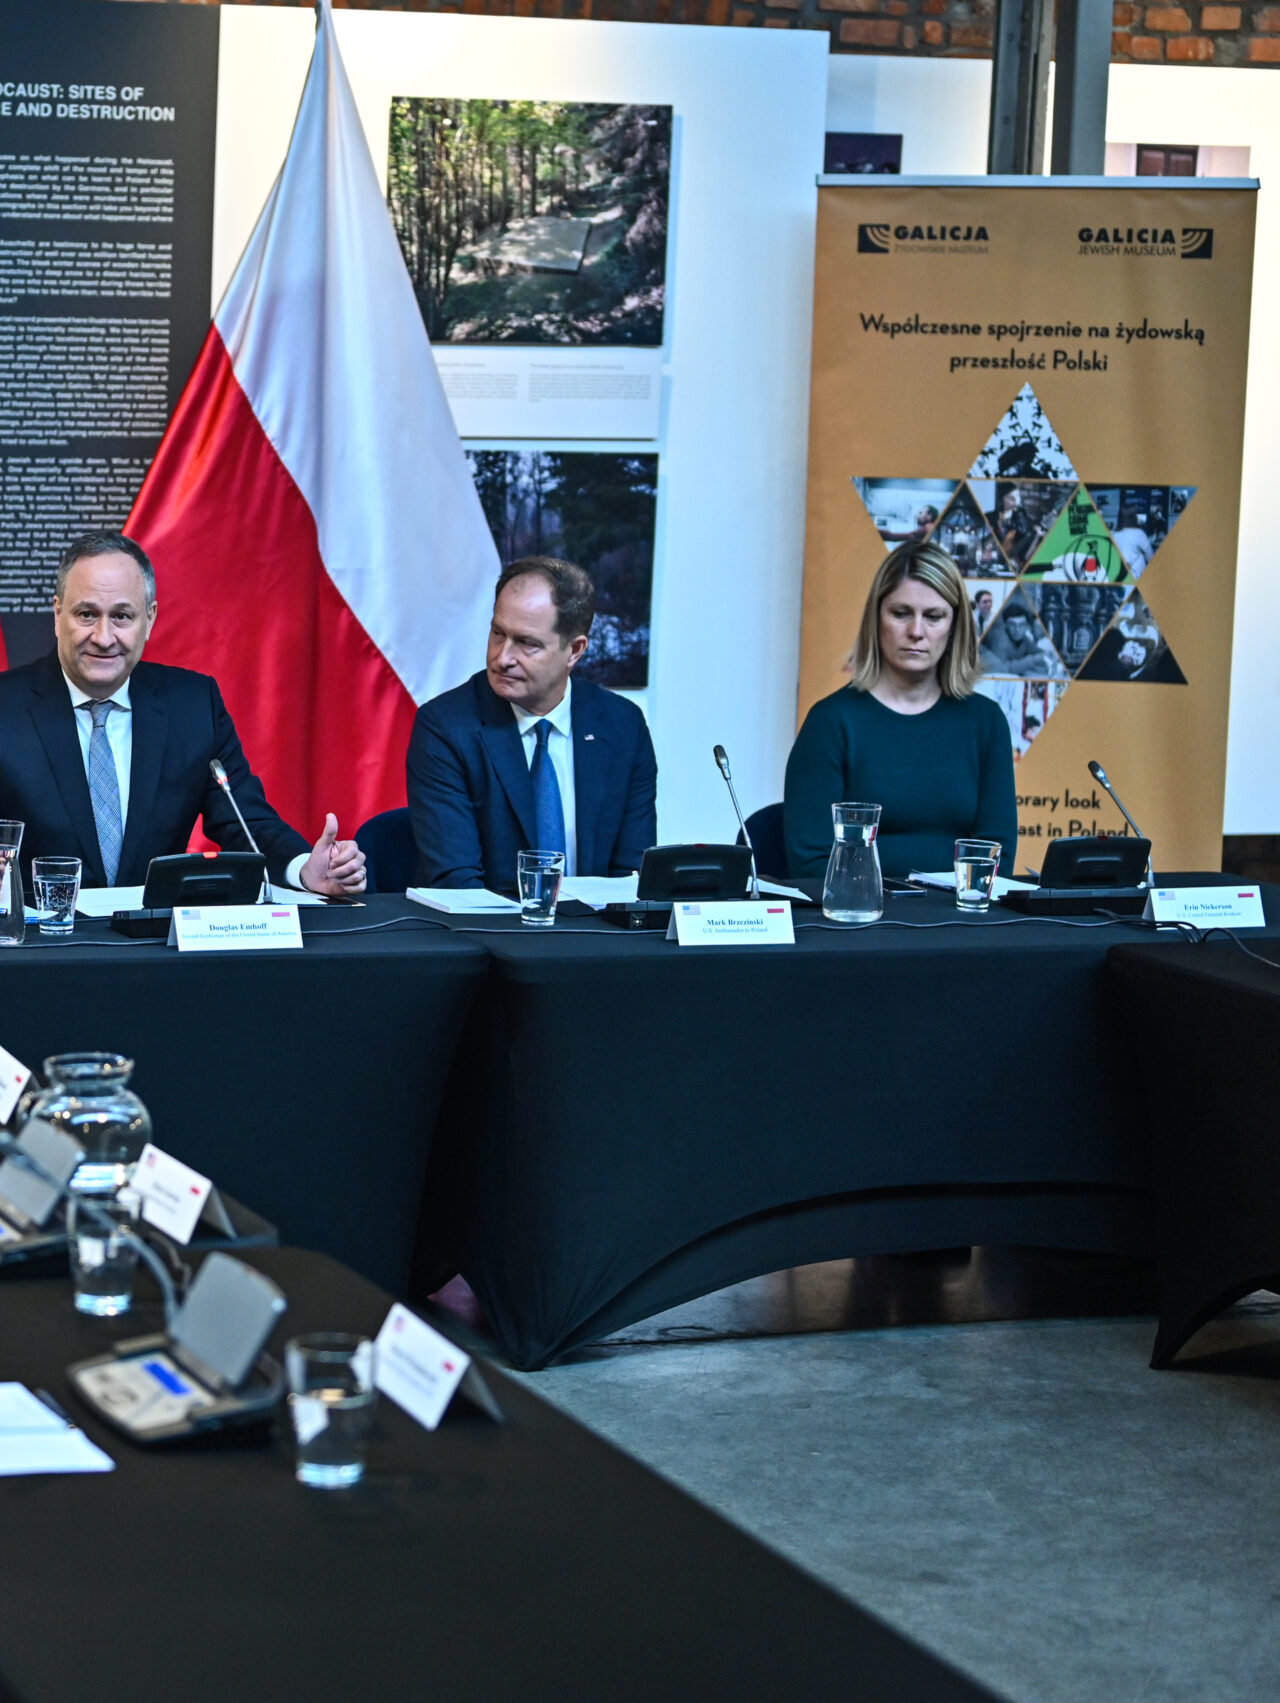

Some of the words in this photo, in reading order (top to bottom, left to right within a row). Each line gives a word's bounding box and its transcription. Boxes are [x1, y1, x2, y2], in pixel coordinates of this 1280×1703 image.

[68, 84, 117, 100] SITES
[121, 86, 144, 102] OF
[16, 102, 52, 118] AND
[56, 103, 176, 122] DESTRUCTION
[894, 225, 989, 242] GALICJA
[1078, 227, 1176, 243] GALICIA
[1078, 244, 1120, 256] JEWISH
[1124, 246, 1176, 256] MUSEUM
[860, 314, 982, 338] Współczesne
[988, 321, 1082, 341] spojrzenie
[1088, 325, 1109, 338] na
[1116, 318, 1205, 345] żydowską
[950, 348, 1046, 372] przeszłość
[1054, 350, 1108, 372] Polski
[1065, 790, 1100, 809] look
[1018, 823, 1042, 837] ast
[1048, 822, 1062, 837] in
[209, 924, 238, 932] Douglas
